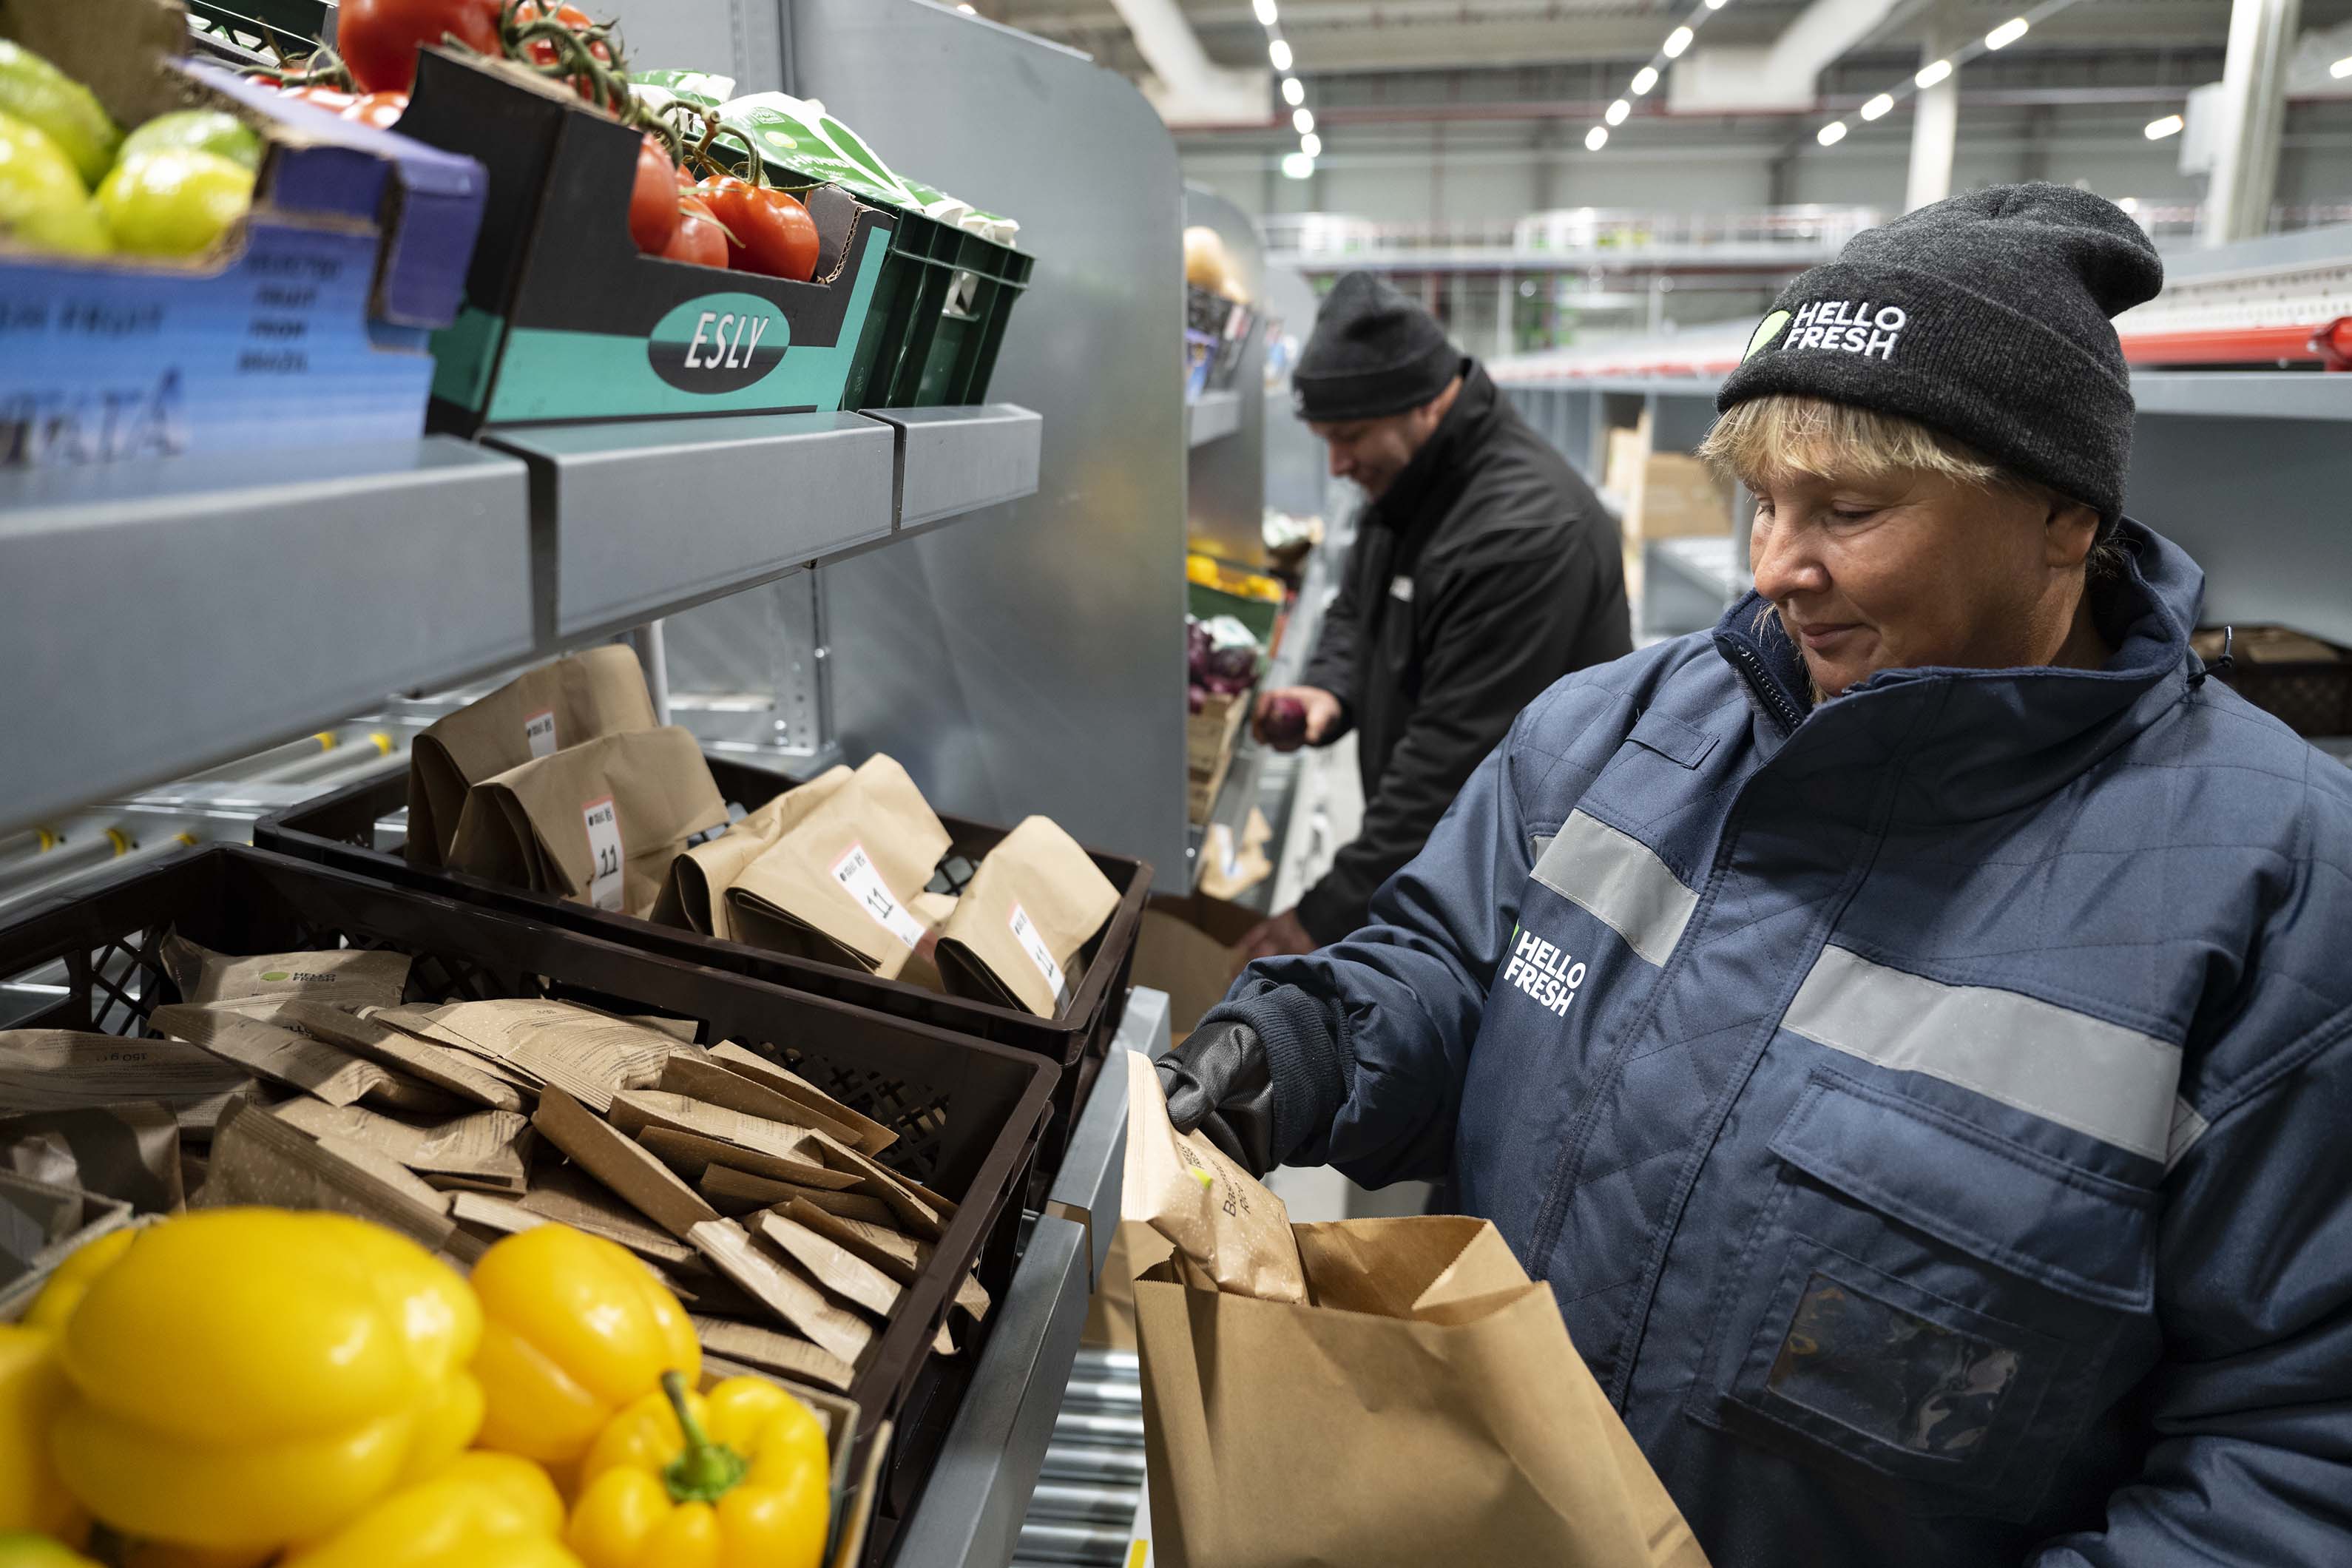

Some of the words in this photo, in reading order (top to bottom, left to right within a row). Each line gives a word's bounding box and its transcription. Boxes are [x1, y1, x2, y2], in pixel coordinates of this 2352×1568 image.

[1793, 300, 1907, 331] HELLO
[684, 311, 770, 370] ESLY
[1782, 326, 1899, 360] FRESH
[600, 845, 618, 879] 11
[867, 888, 894, 919] 11
[1515, 930, 1586, 990] HELLO
[1503, 955, 1575, 1017] FRESH
